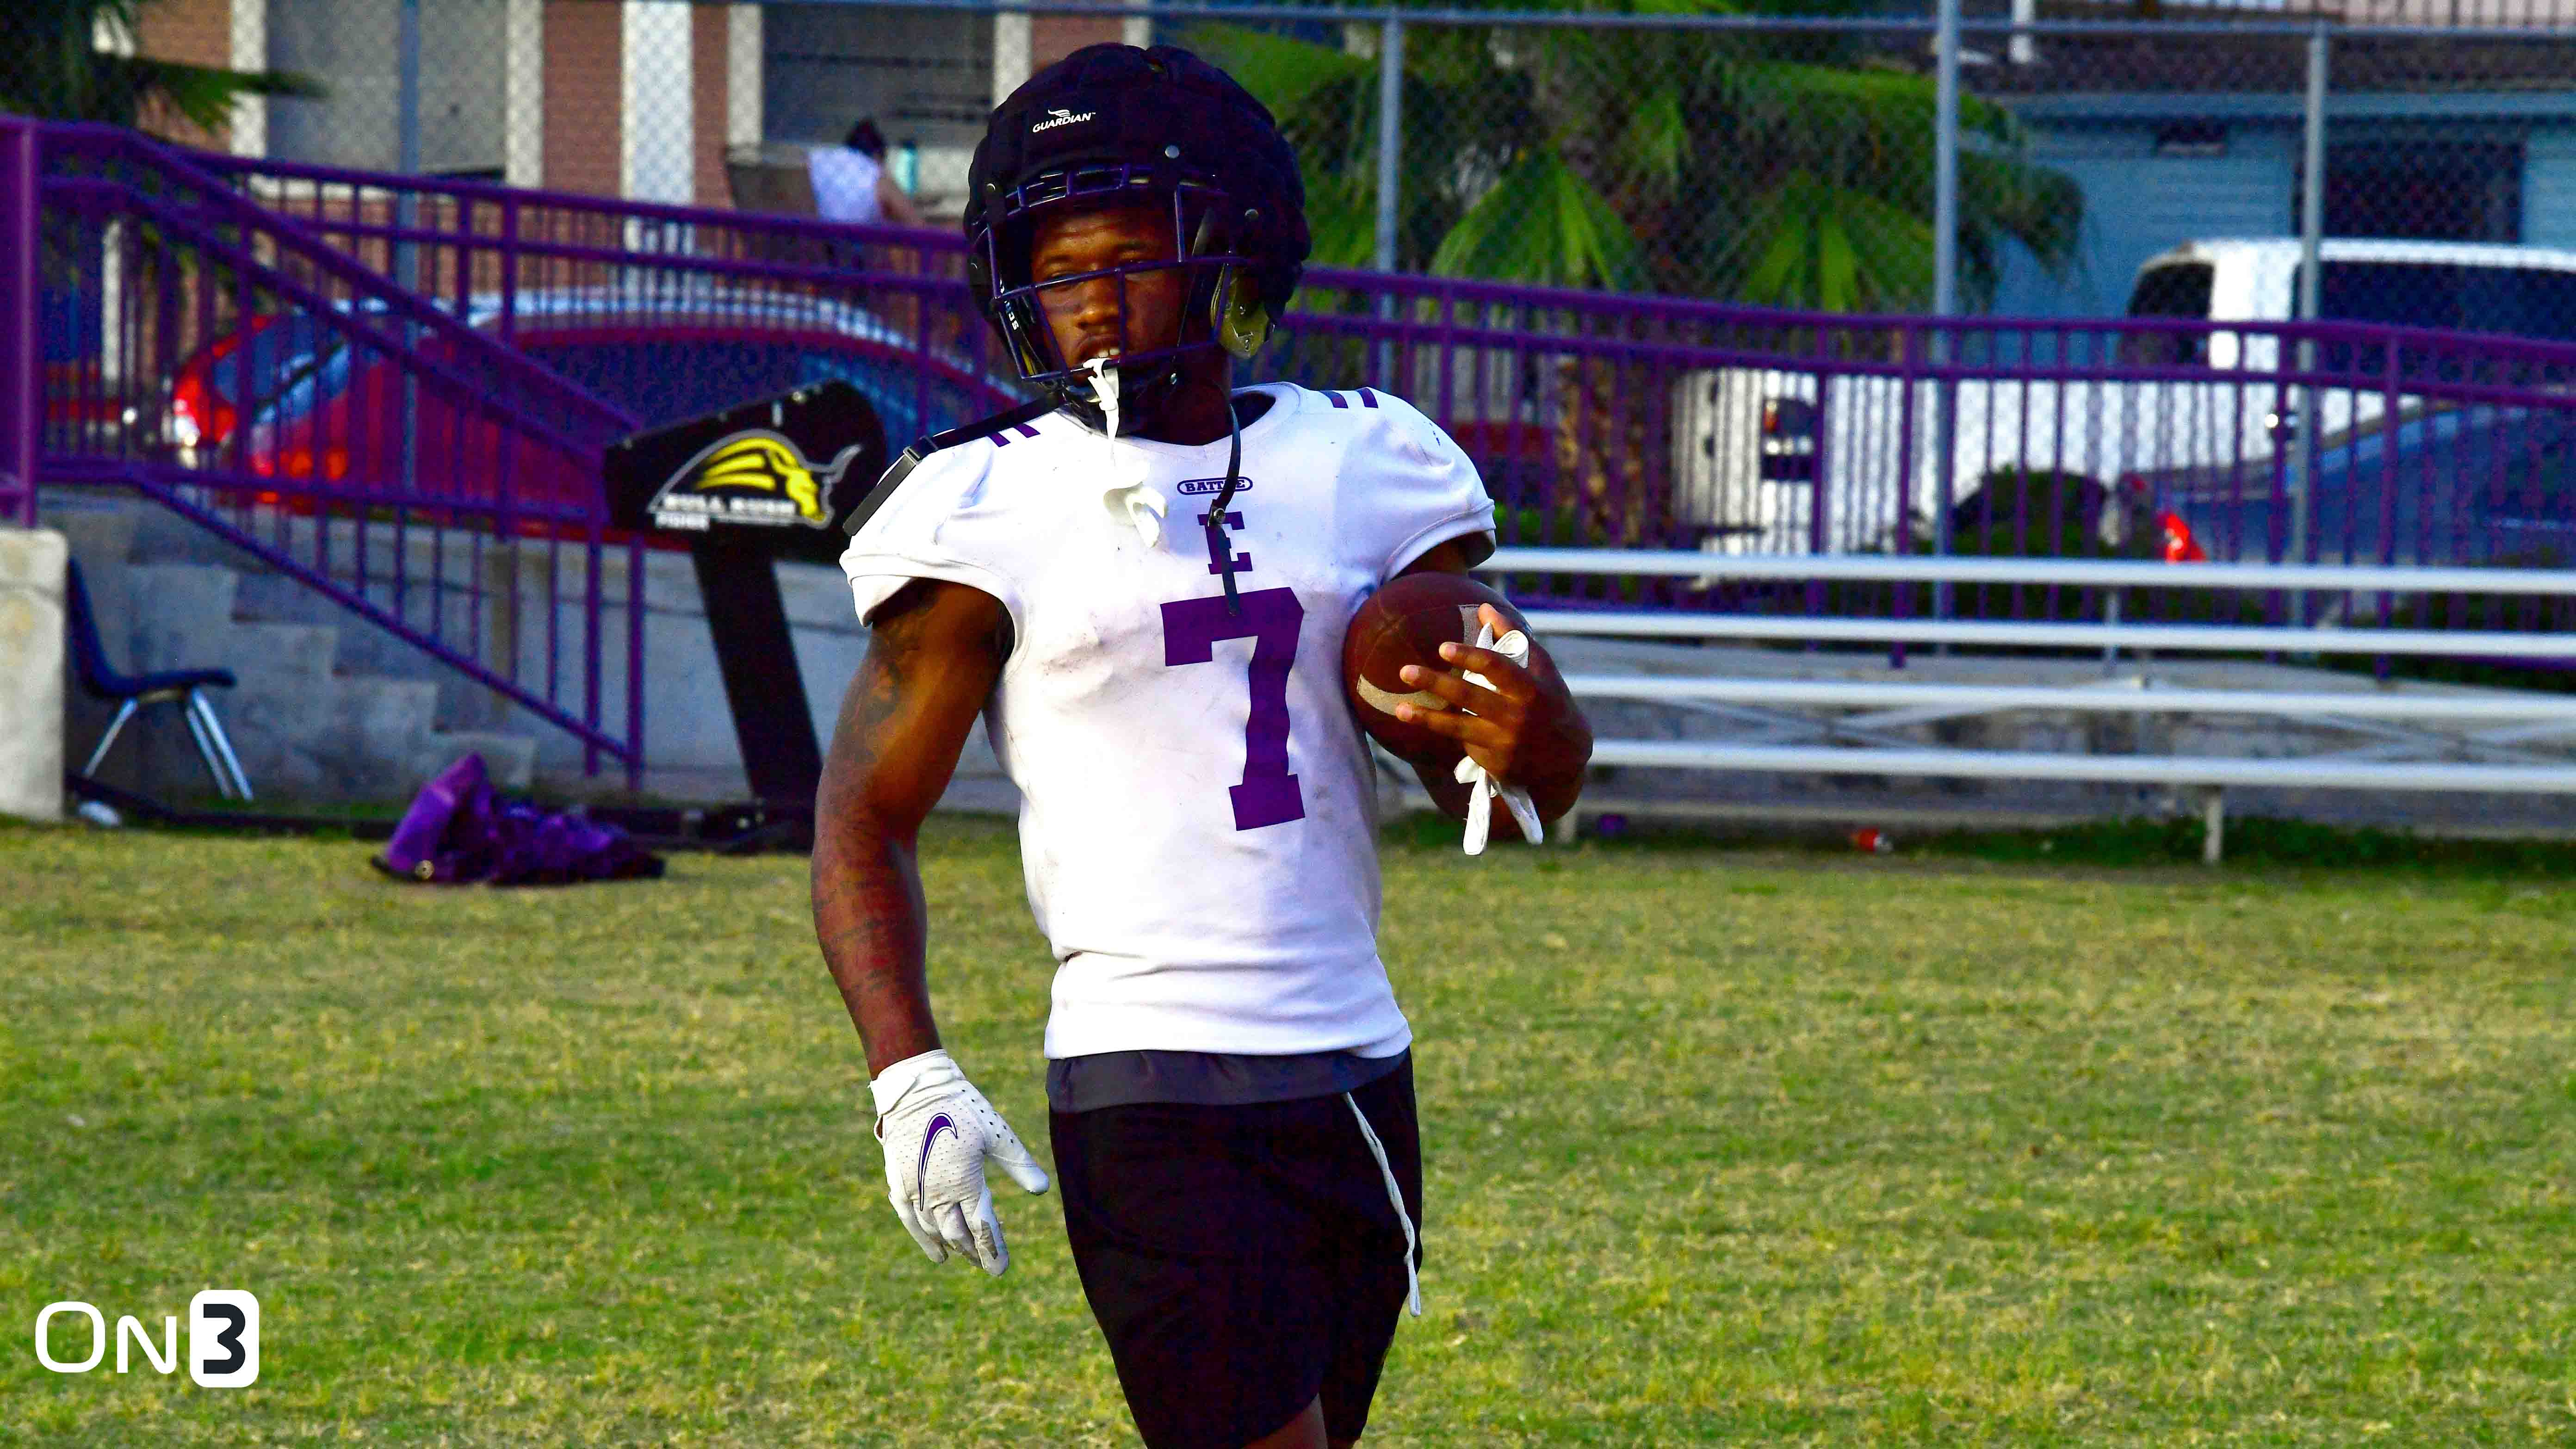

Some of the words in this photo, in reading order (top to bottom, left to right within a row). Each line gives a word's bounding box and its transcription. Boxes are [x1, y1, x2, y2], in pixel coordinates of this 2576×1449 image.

[1032, 112, 1092, 133] GUARDIAN
[1185, 479, 1245, 492] BATTE
[1197, 511, 1253, 575] E
[1160, 587, 1306, 831] 7
